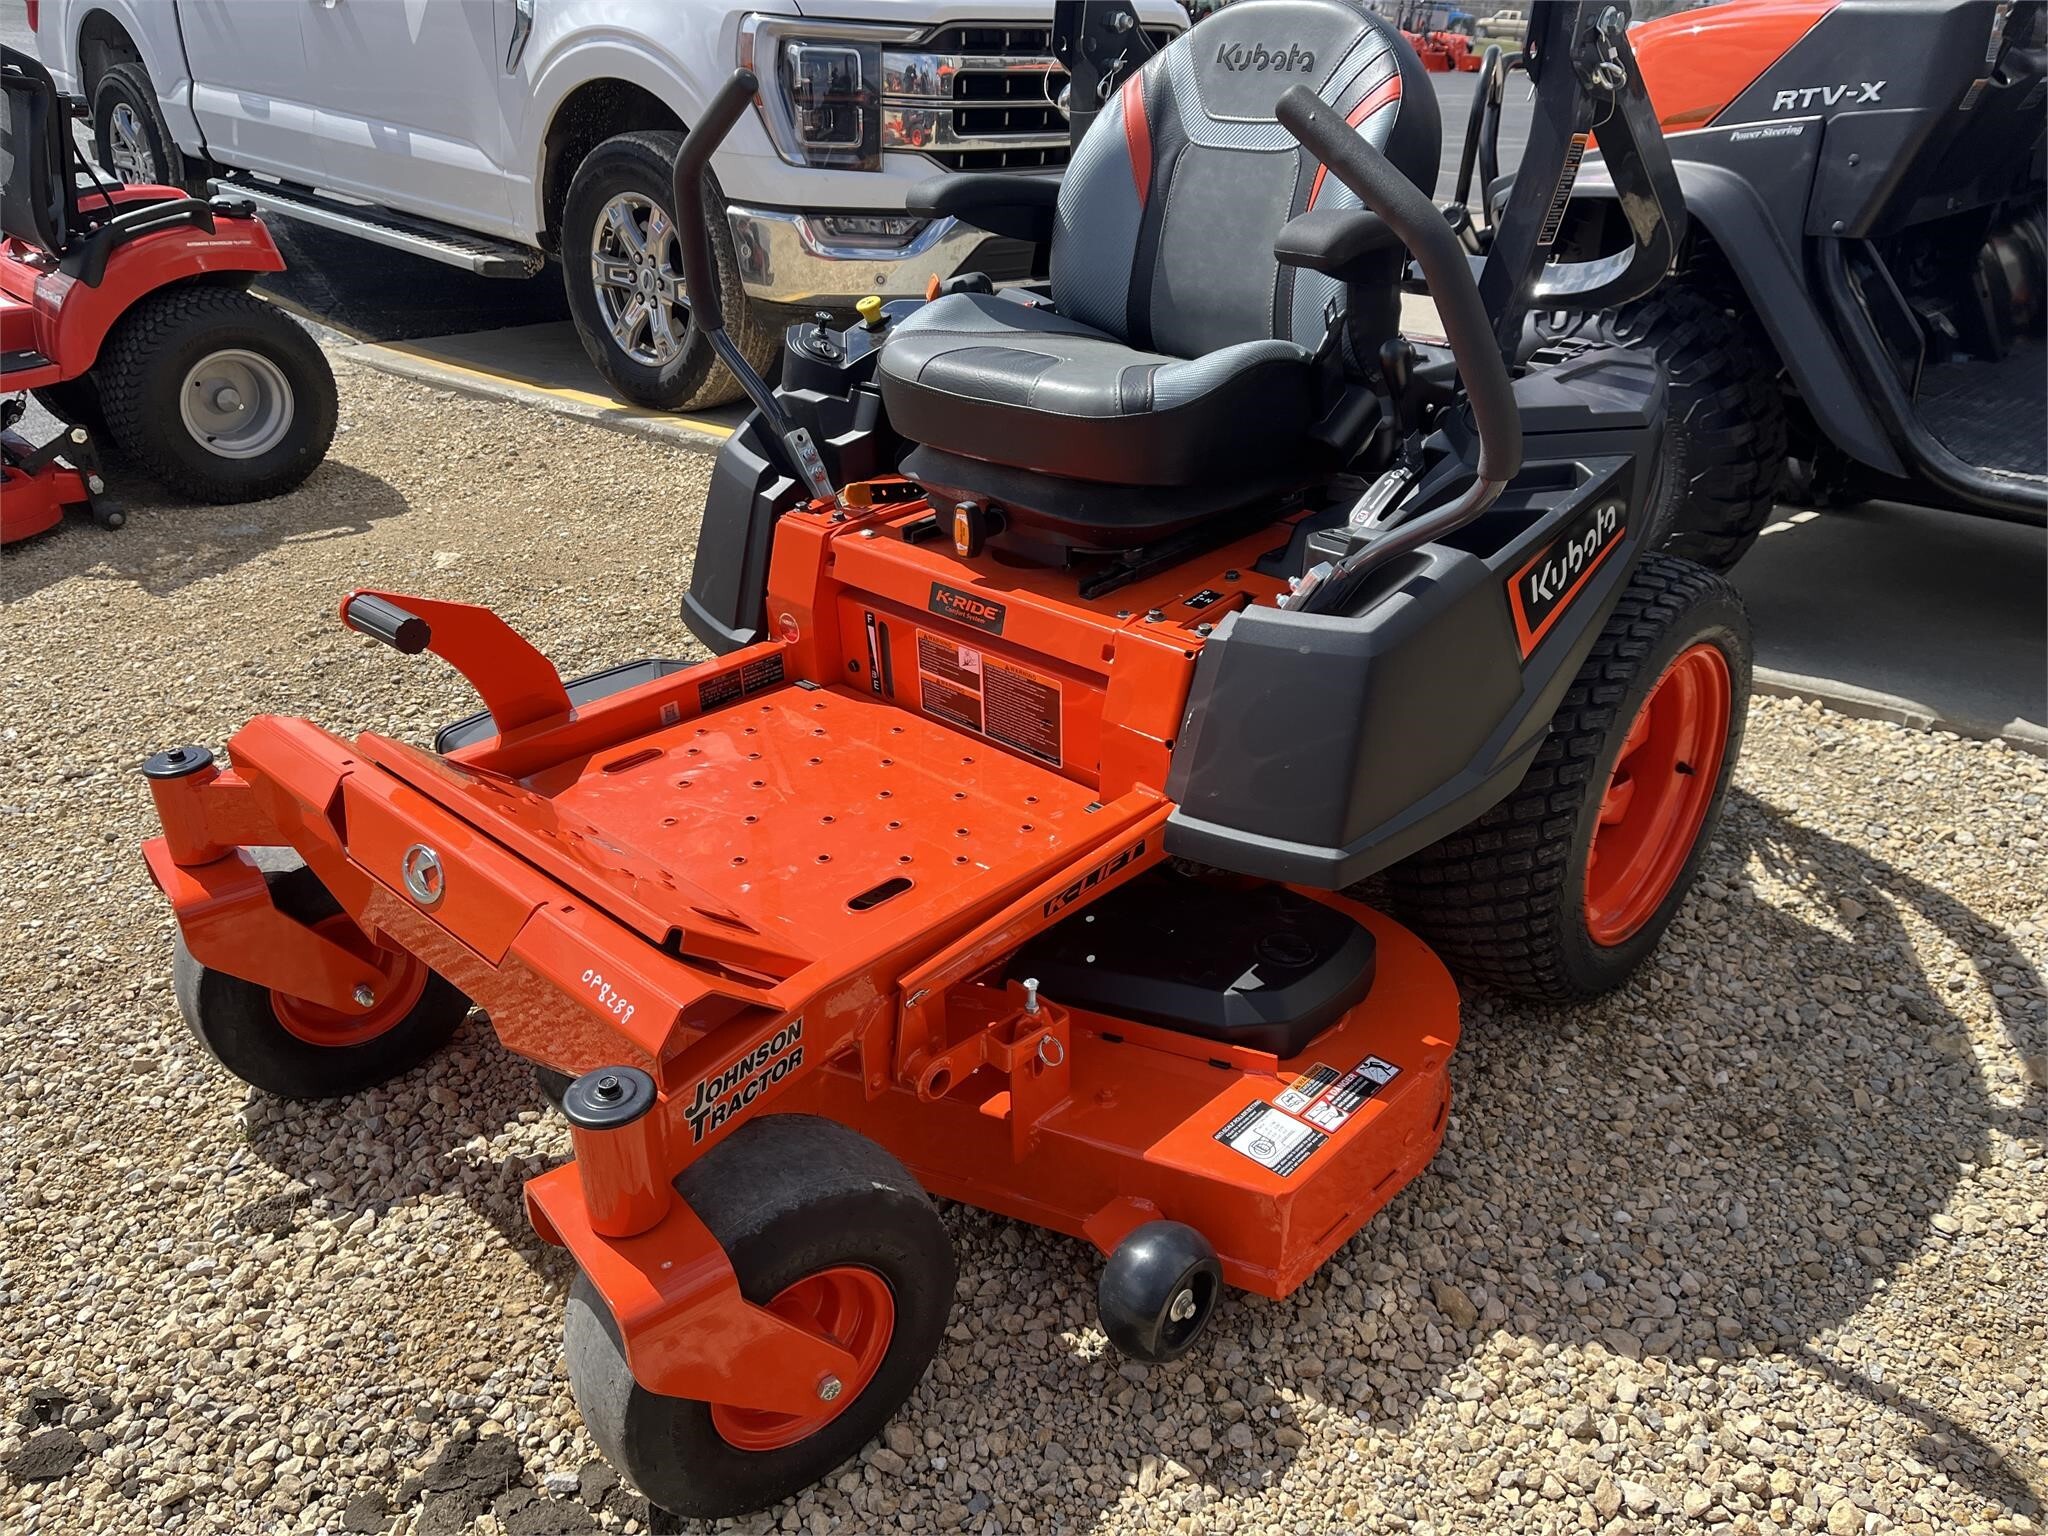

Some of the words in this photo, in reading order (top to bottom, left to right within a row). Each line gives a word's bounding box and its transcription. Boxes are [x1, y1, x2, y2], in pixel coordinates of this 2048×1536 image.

[1216, 42, 1315, 73] Kubota
[1772, 80, 1887, 112] RTV-X
[1729, 130, 1761, 142] Power
[1761, 124, 1804, 138] Steering
[1531, 505, 1616, 604] Kubota
[936, 589, 998, 621] K-RIDE
[1047, 840, 1144, 916] K-LIFT
[684, 1016, 803, 1120] JOHNSON
[688, 1045, 804, 1146] TRACTOR
[1329, 1072, 1358, 1097] DANGER
